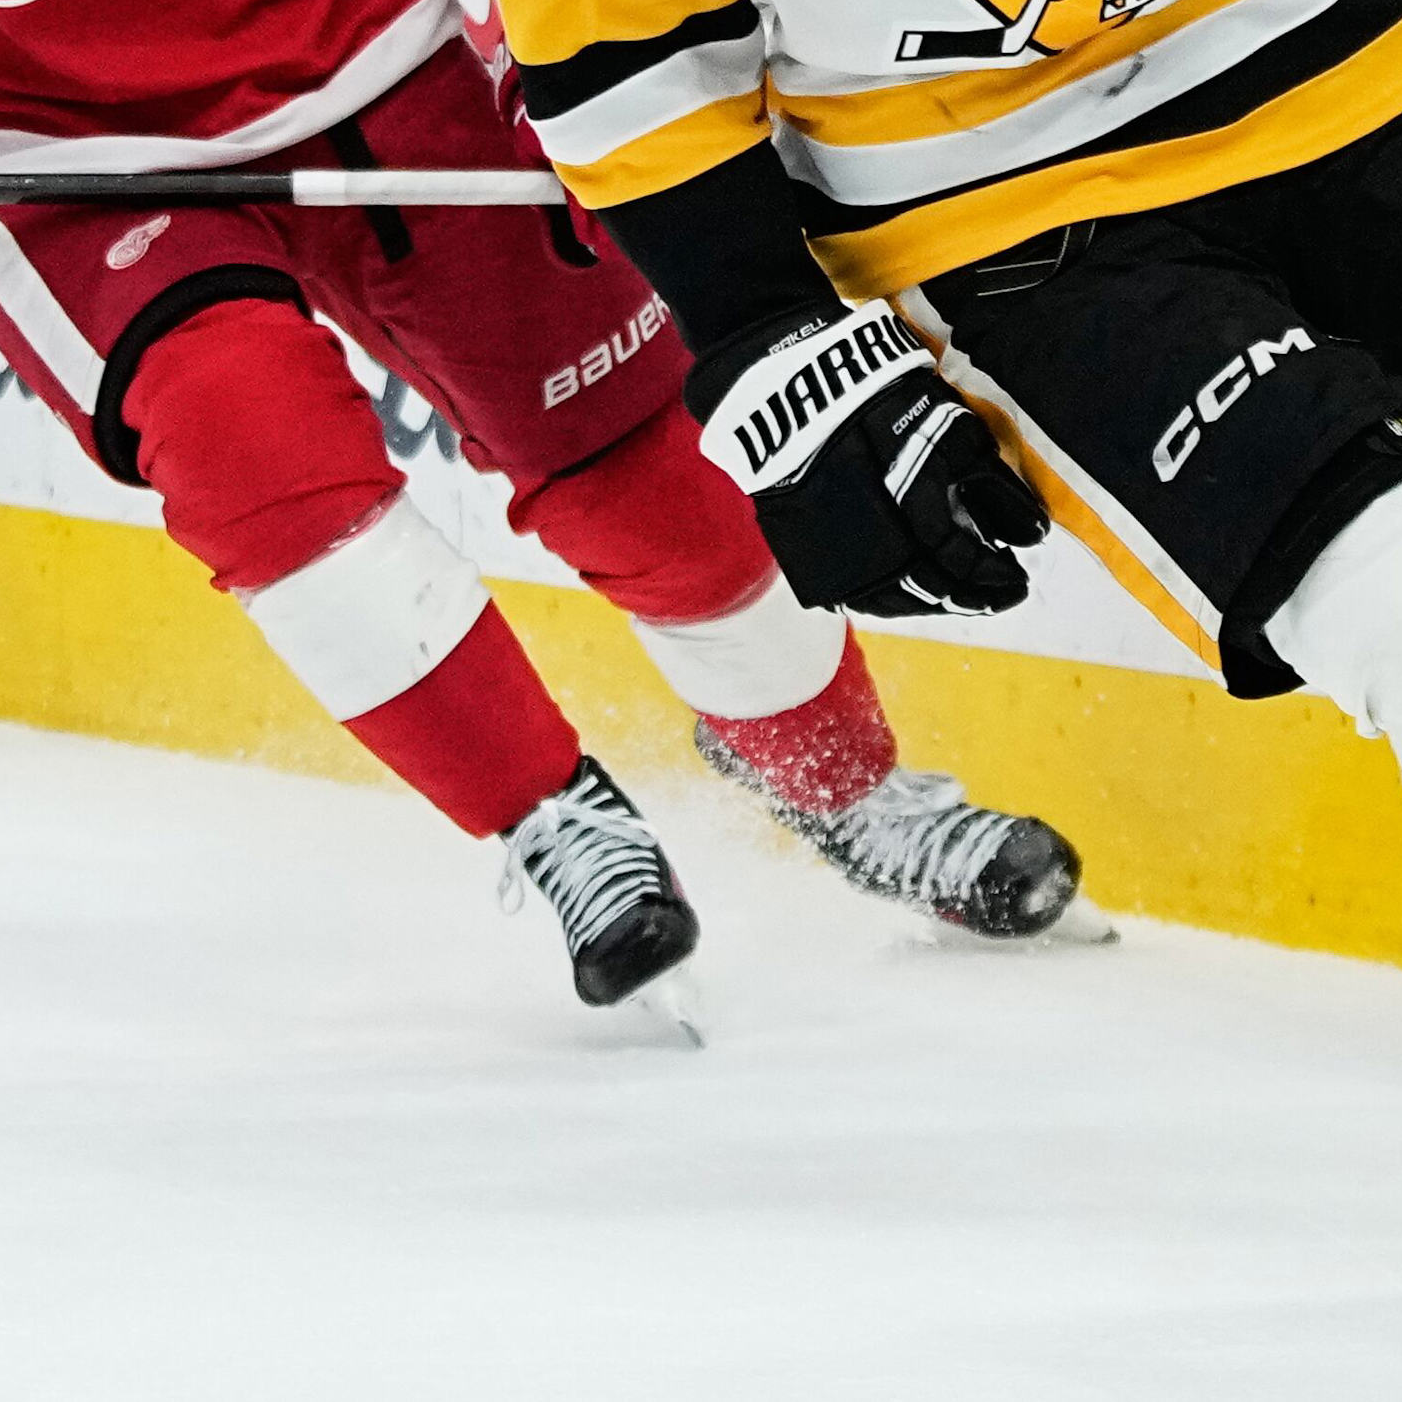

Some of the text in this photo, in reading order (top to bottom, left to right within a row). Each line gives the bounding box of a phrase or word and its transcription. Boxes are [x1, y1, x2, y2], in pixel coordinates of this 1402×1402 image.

[768, 317, 829, 356] RAKELL
[892, 395, 932, 436] COVERT
[1152, 327, 1317, 483] CCM
